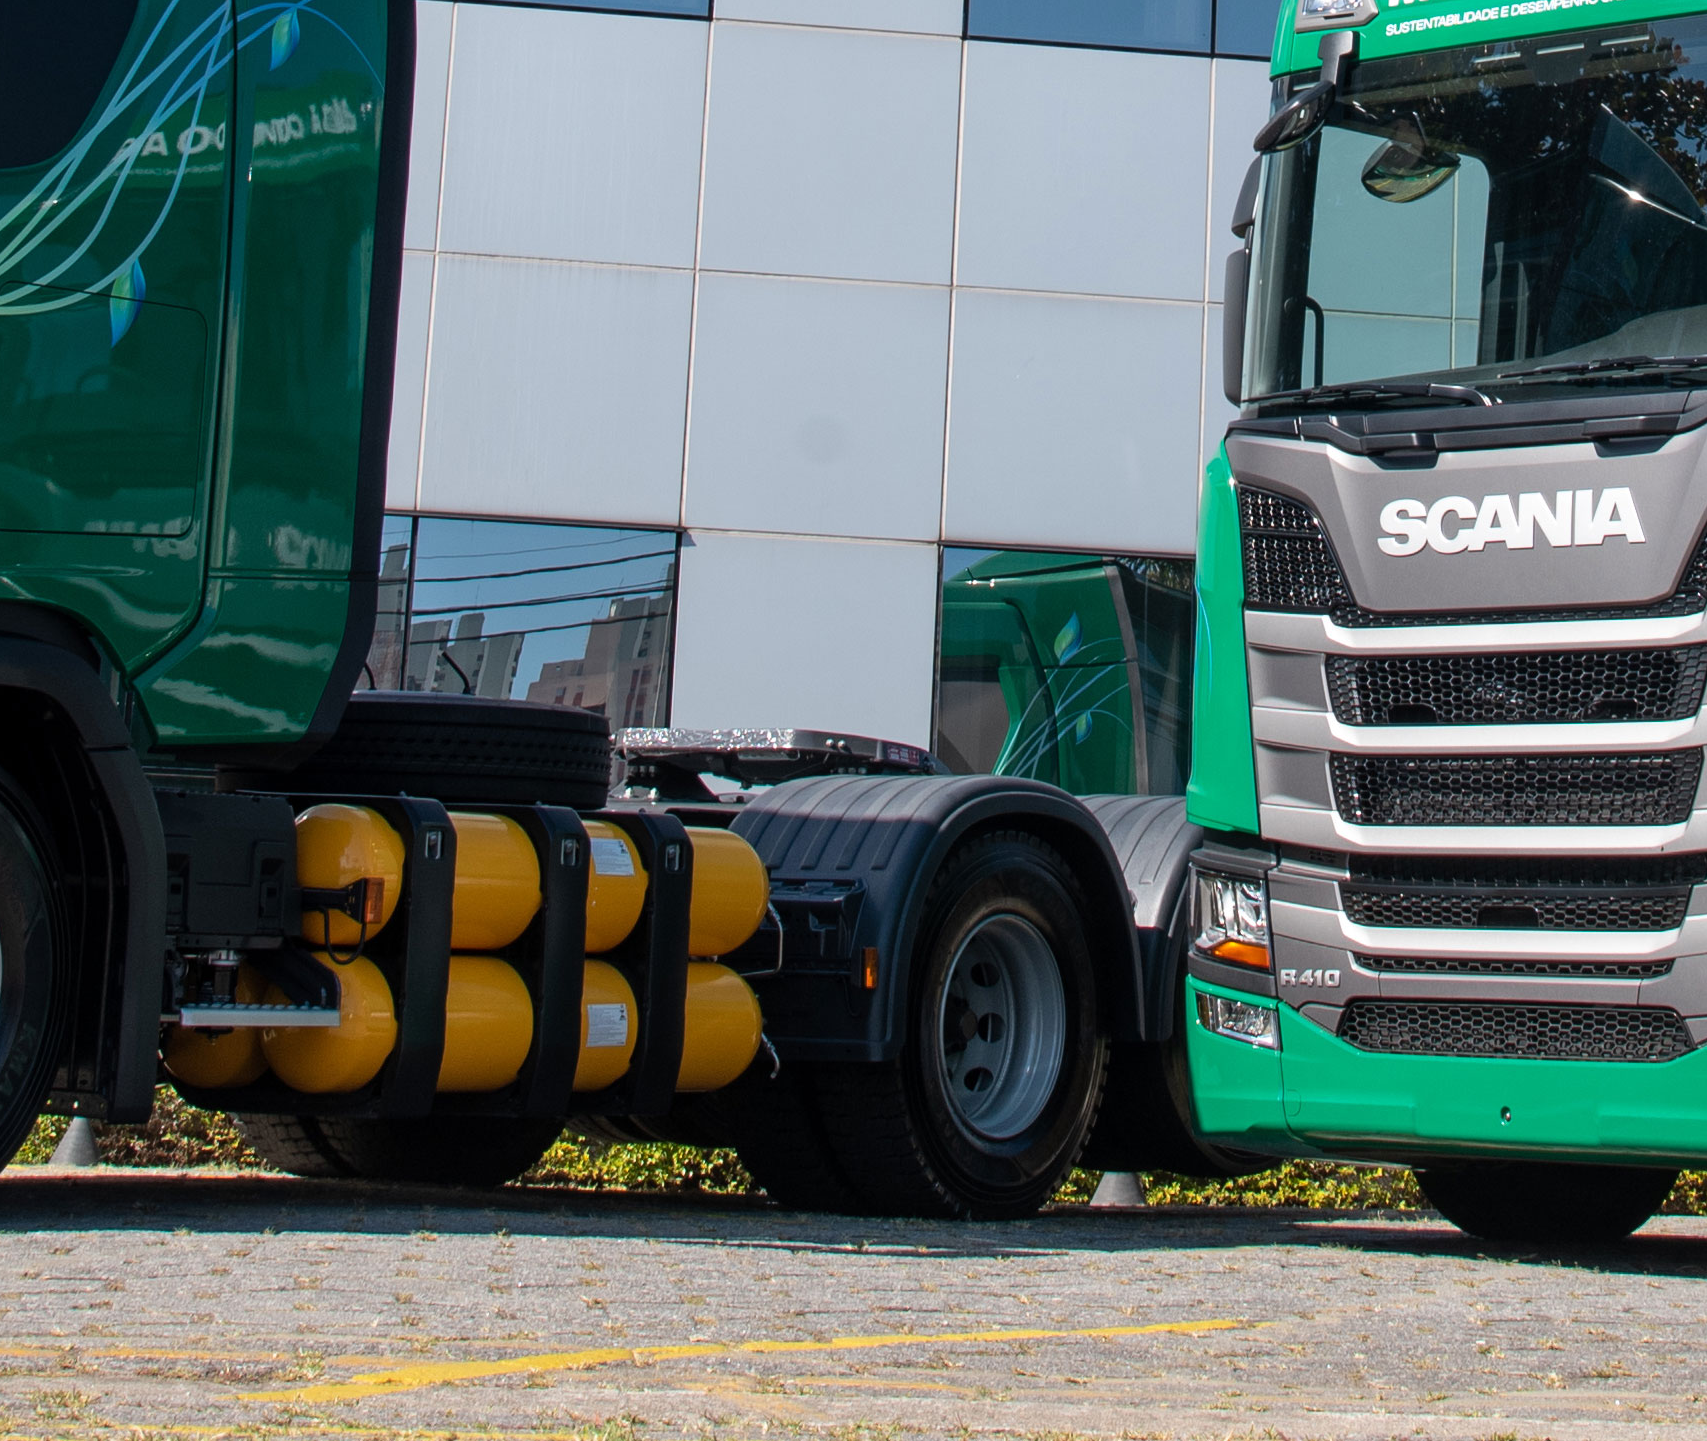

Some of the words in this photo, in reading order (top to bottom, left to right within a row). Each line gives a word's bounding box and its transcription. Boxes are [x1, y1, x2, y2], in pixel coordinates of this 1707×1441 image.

[1385, 6, 1499, 36] SUSTENTABILIDADE
[1500, 5, 1509, 17] E
[1377, 486, 1646, 557] SCANIA
